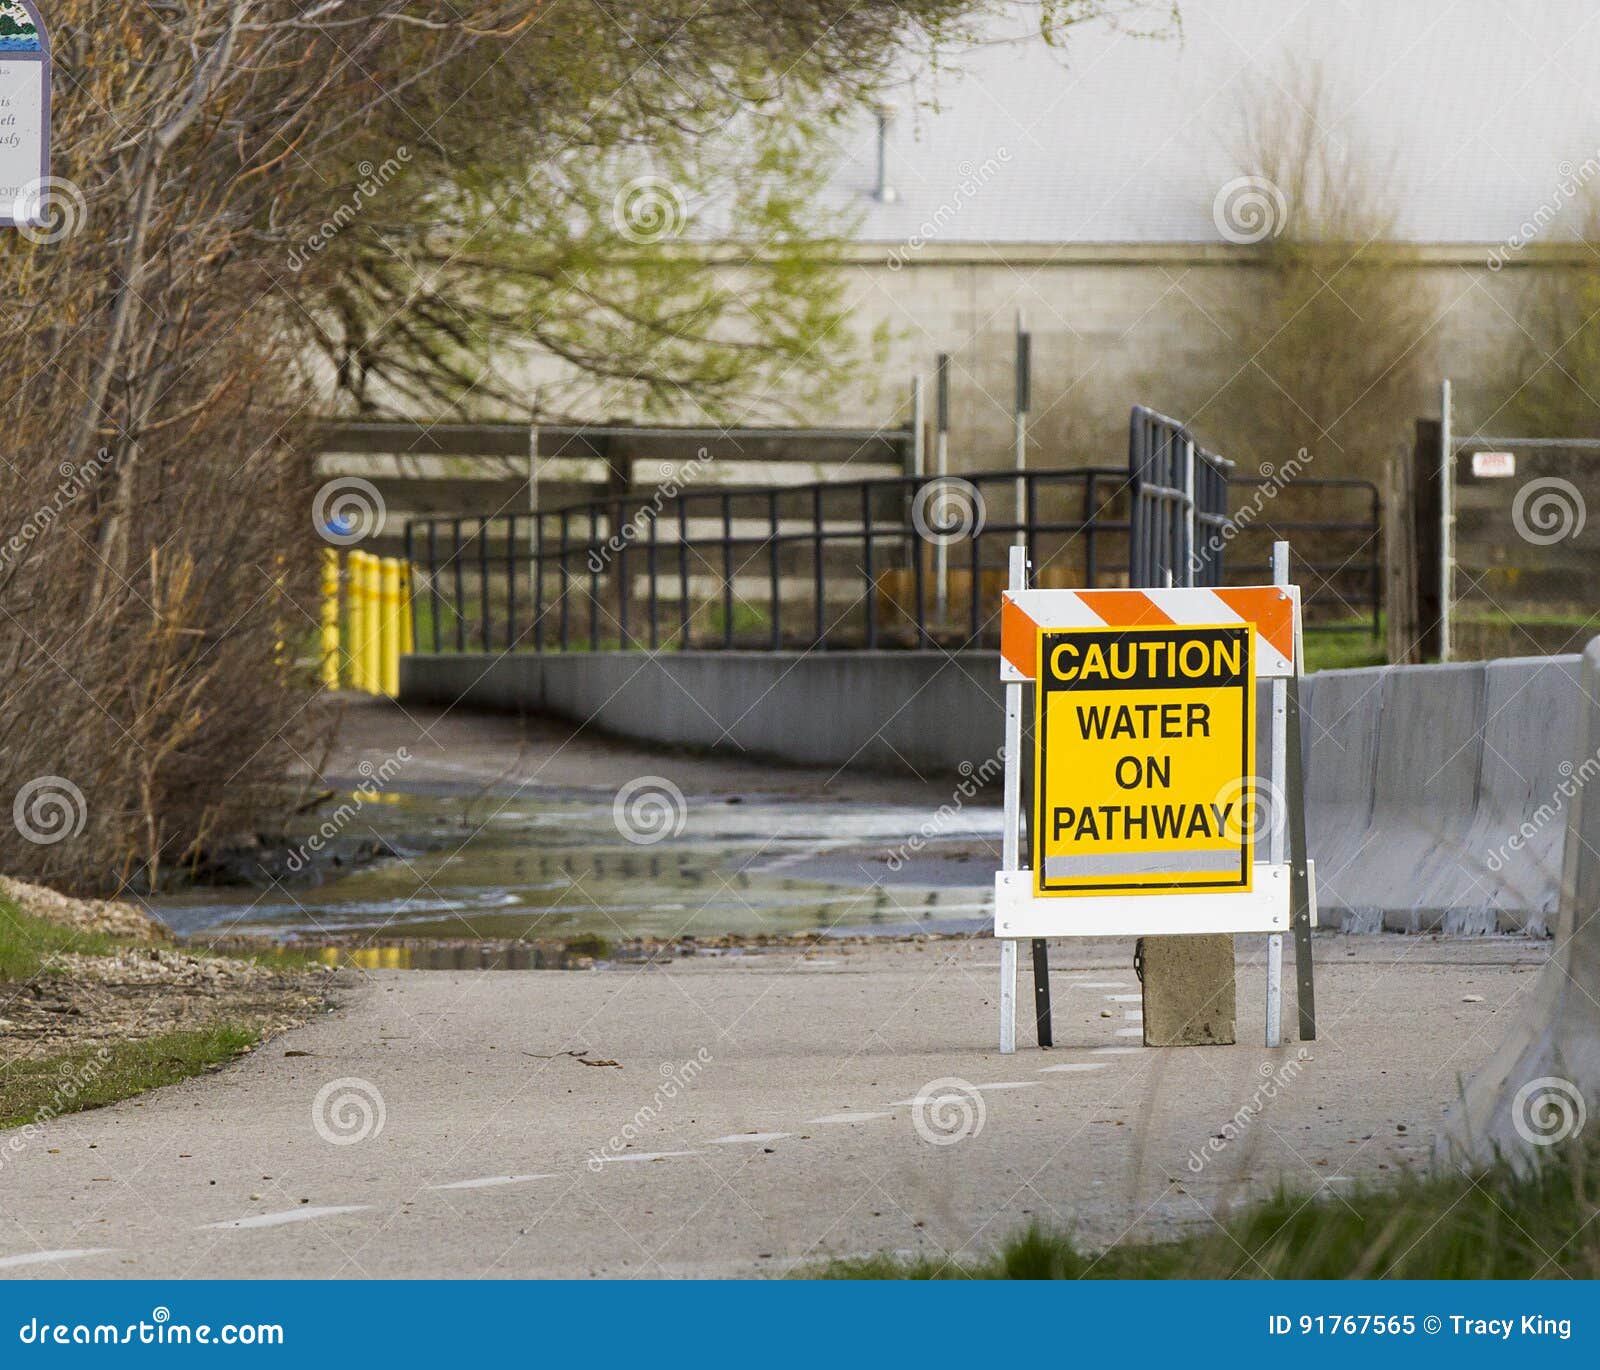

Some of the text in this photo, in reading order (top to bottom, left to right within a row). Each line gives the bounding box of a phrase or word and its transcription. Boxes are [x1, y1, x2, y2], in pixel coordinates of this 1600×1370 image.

[1050, 639, 1241, 681] CAUTION
[1076, 703, 1211, 740] WATER
[1115, 755, 1171, 790] ON
[1053, 803, 1233, 842] PATHWAY
